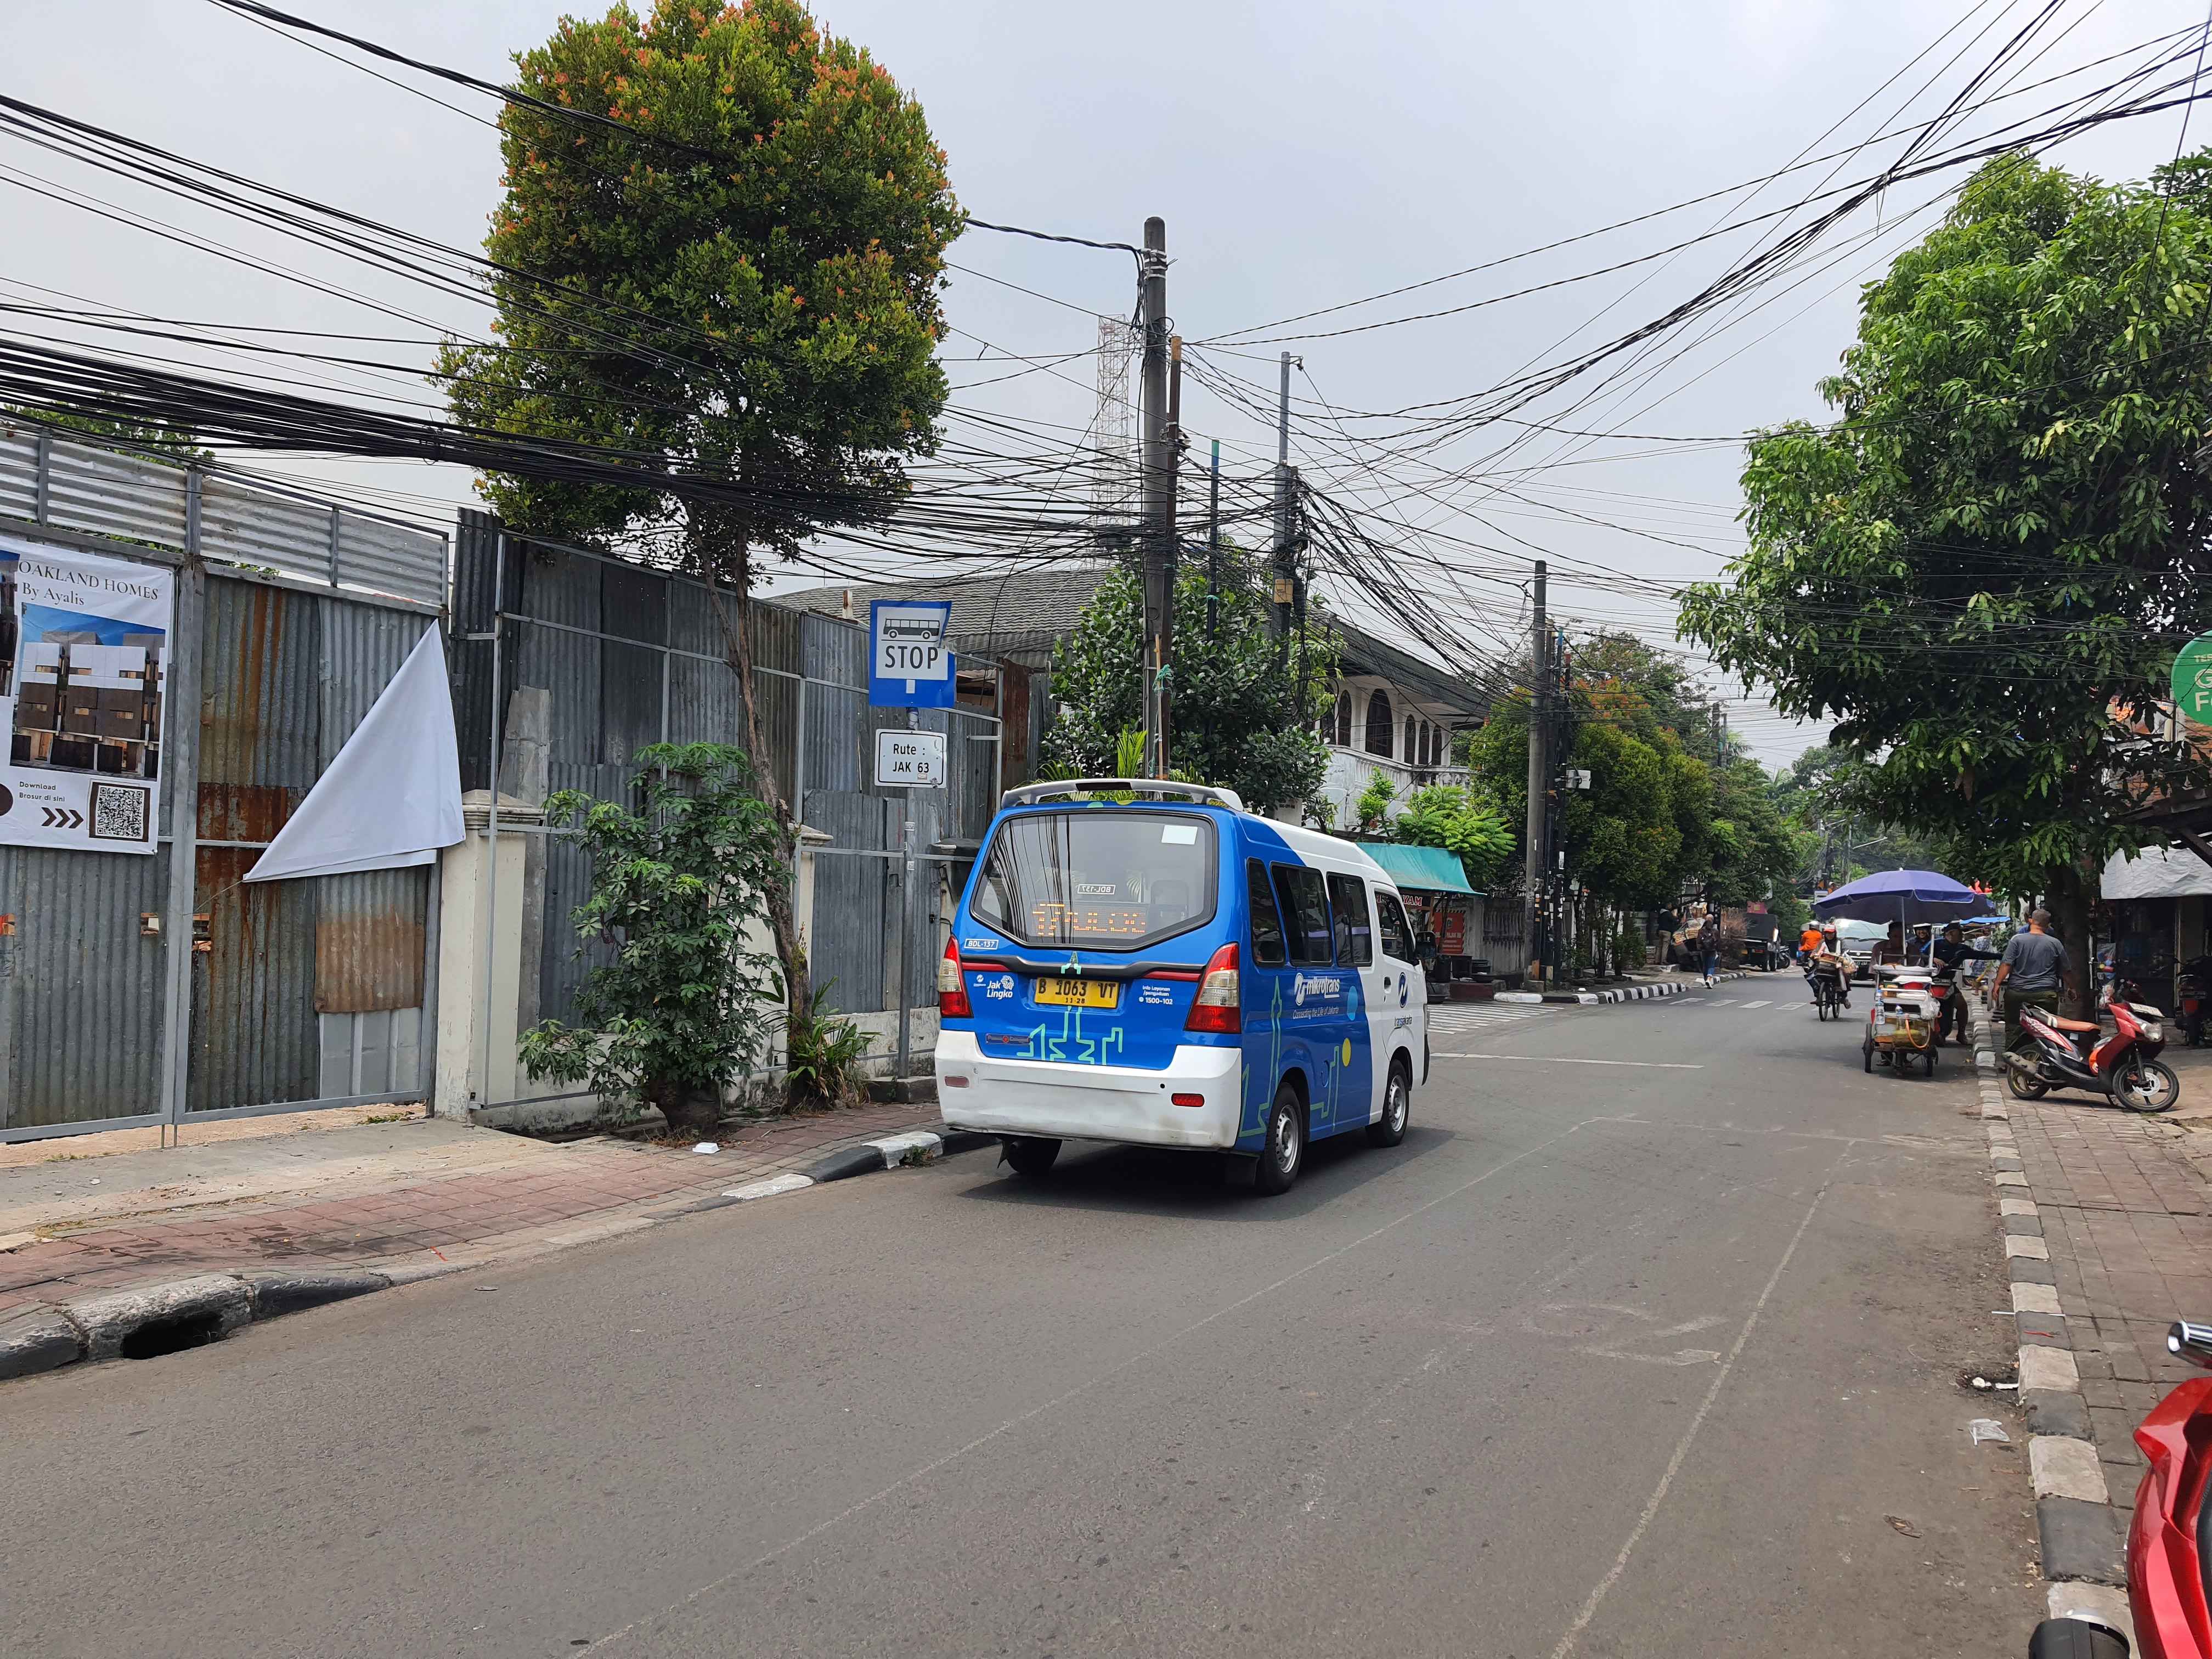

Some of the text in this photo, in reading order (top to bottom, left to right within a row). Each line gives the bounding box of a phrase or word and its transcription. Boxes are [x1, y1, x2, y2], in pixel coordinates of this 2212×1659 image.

[19, 561, 159, 600] OAKLAND HOMES
[22, 582, 84, 606] By Ayalis
[885, 645, 938, 669] STOP
[2195, 691, 2212, 712] F
[893, 743, 916, 755] Rute
[893, 761, 929, 773] JAK 63
[19, 781, 56, 791] Download
[1401, 894, 1423, 906] YAM
[987, 980, 1001, 989] Jak
[1039, 978, 1116, 998] B 1063 VT
[1306, 976, 1340, 998] mikrotrans
[986, 989, 1013, 1000] Lingko
[1145, 997, 1173, 1005] 1500-102
